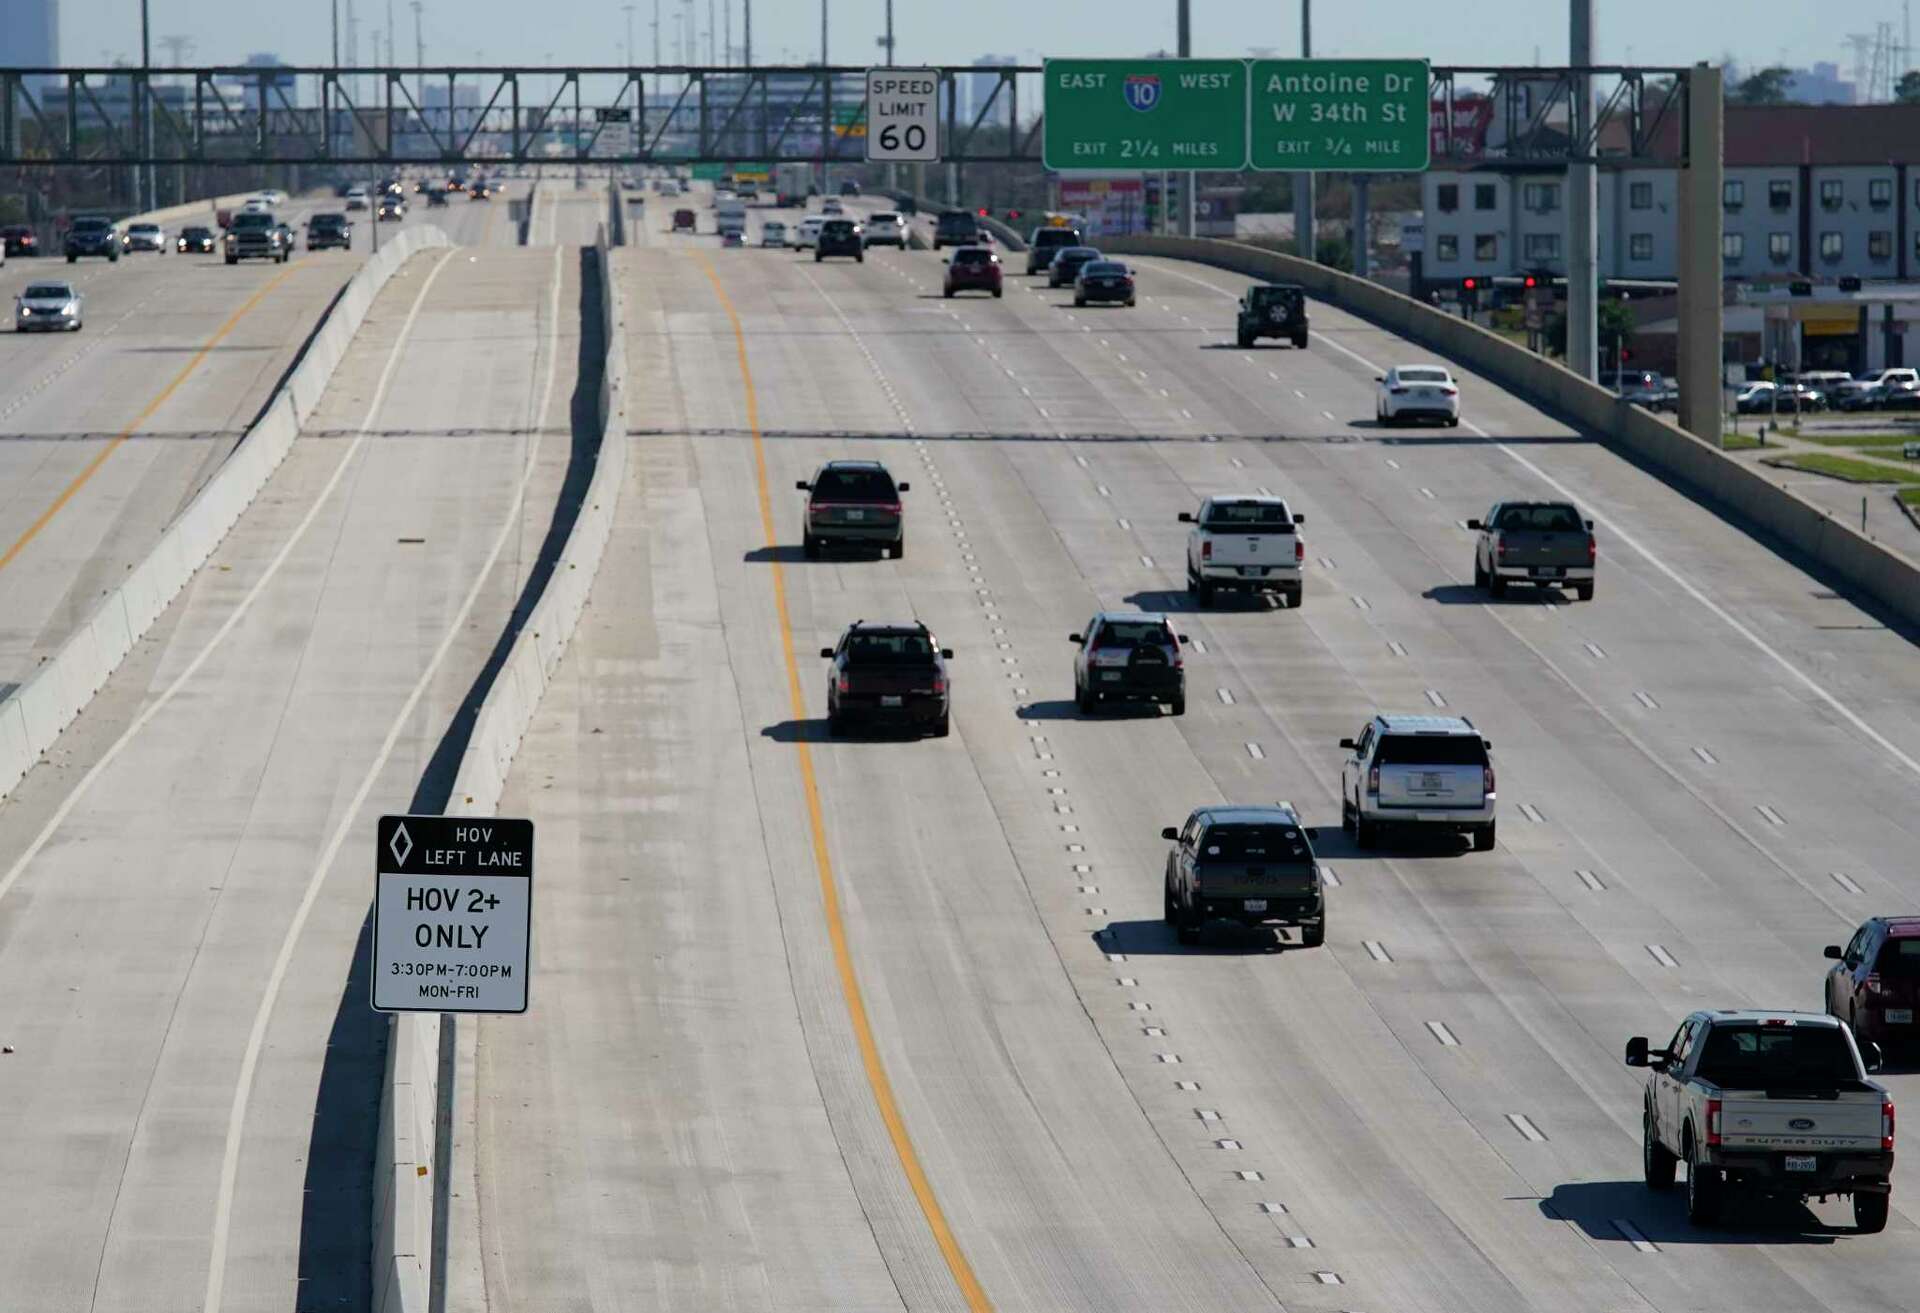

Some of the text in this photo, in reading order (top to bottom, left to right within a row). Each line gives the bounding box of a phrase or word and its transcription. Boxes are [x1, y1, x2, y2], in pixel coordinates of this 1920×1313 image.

[873, 81, 934, 94] SPEED
[1059, 73, 1231, 105] EAST 10 WEST
[1267, 73, 1413, 93] Antoine Dr
[880, 102, 927, 116] LIMIT
[1273, 103, 1406, 122] W 34th St
[880, 124, 926, 151] 60
[1073, 142, 1107, 155] EXIT
[1172, 143, 1217, 155] MILES
[1277, 141, 1311, 153] EXIT
[1366, 141, 1401, 153] MILE
[456, 827, 492, 842] HOV
[425, 850, 522, 866] LEFT LANE
[407, 887, 500, 912] HOV 2+
[415, 924, 489, 949] ONLY
[391, 963, 512, 978] 3:30PM-7:00PM
[419, 985, 479, 998] MON-FRI
[1745, 1137, 1858, 1146] SUPER DUTY
